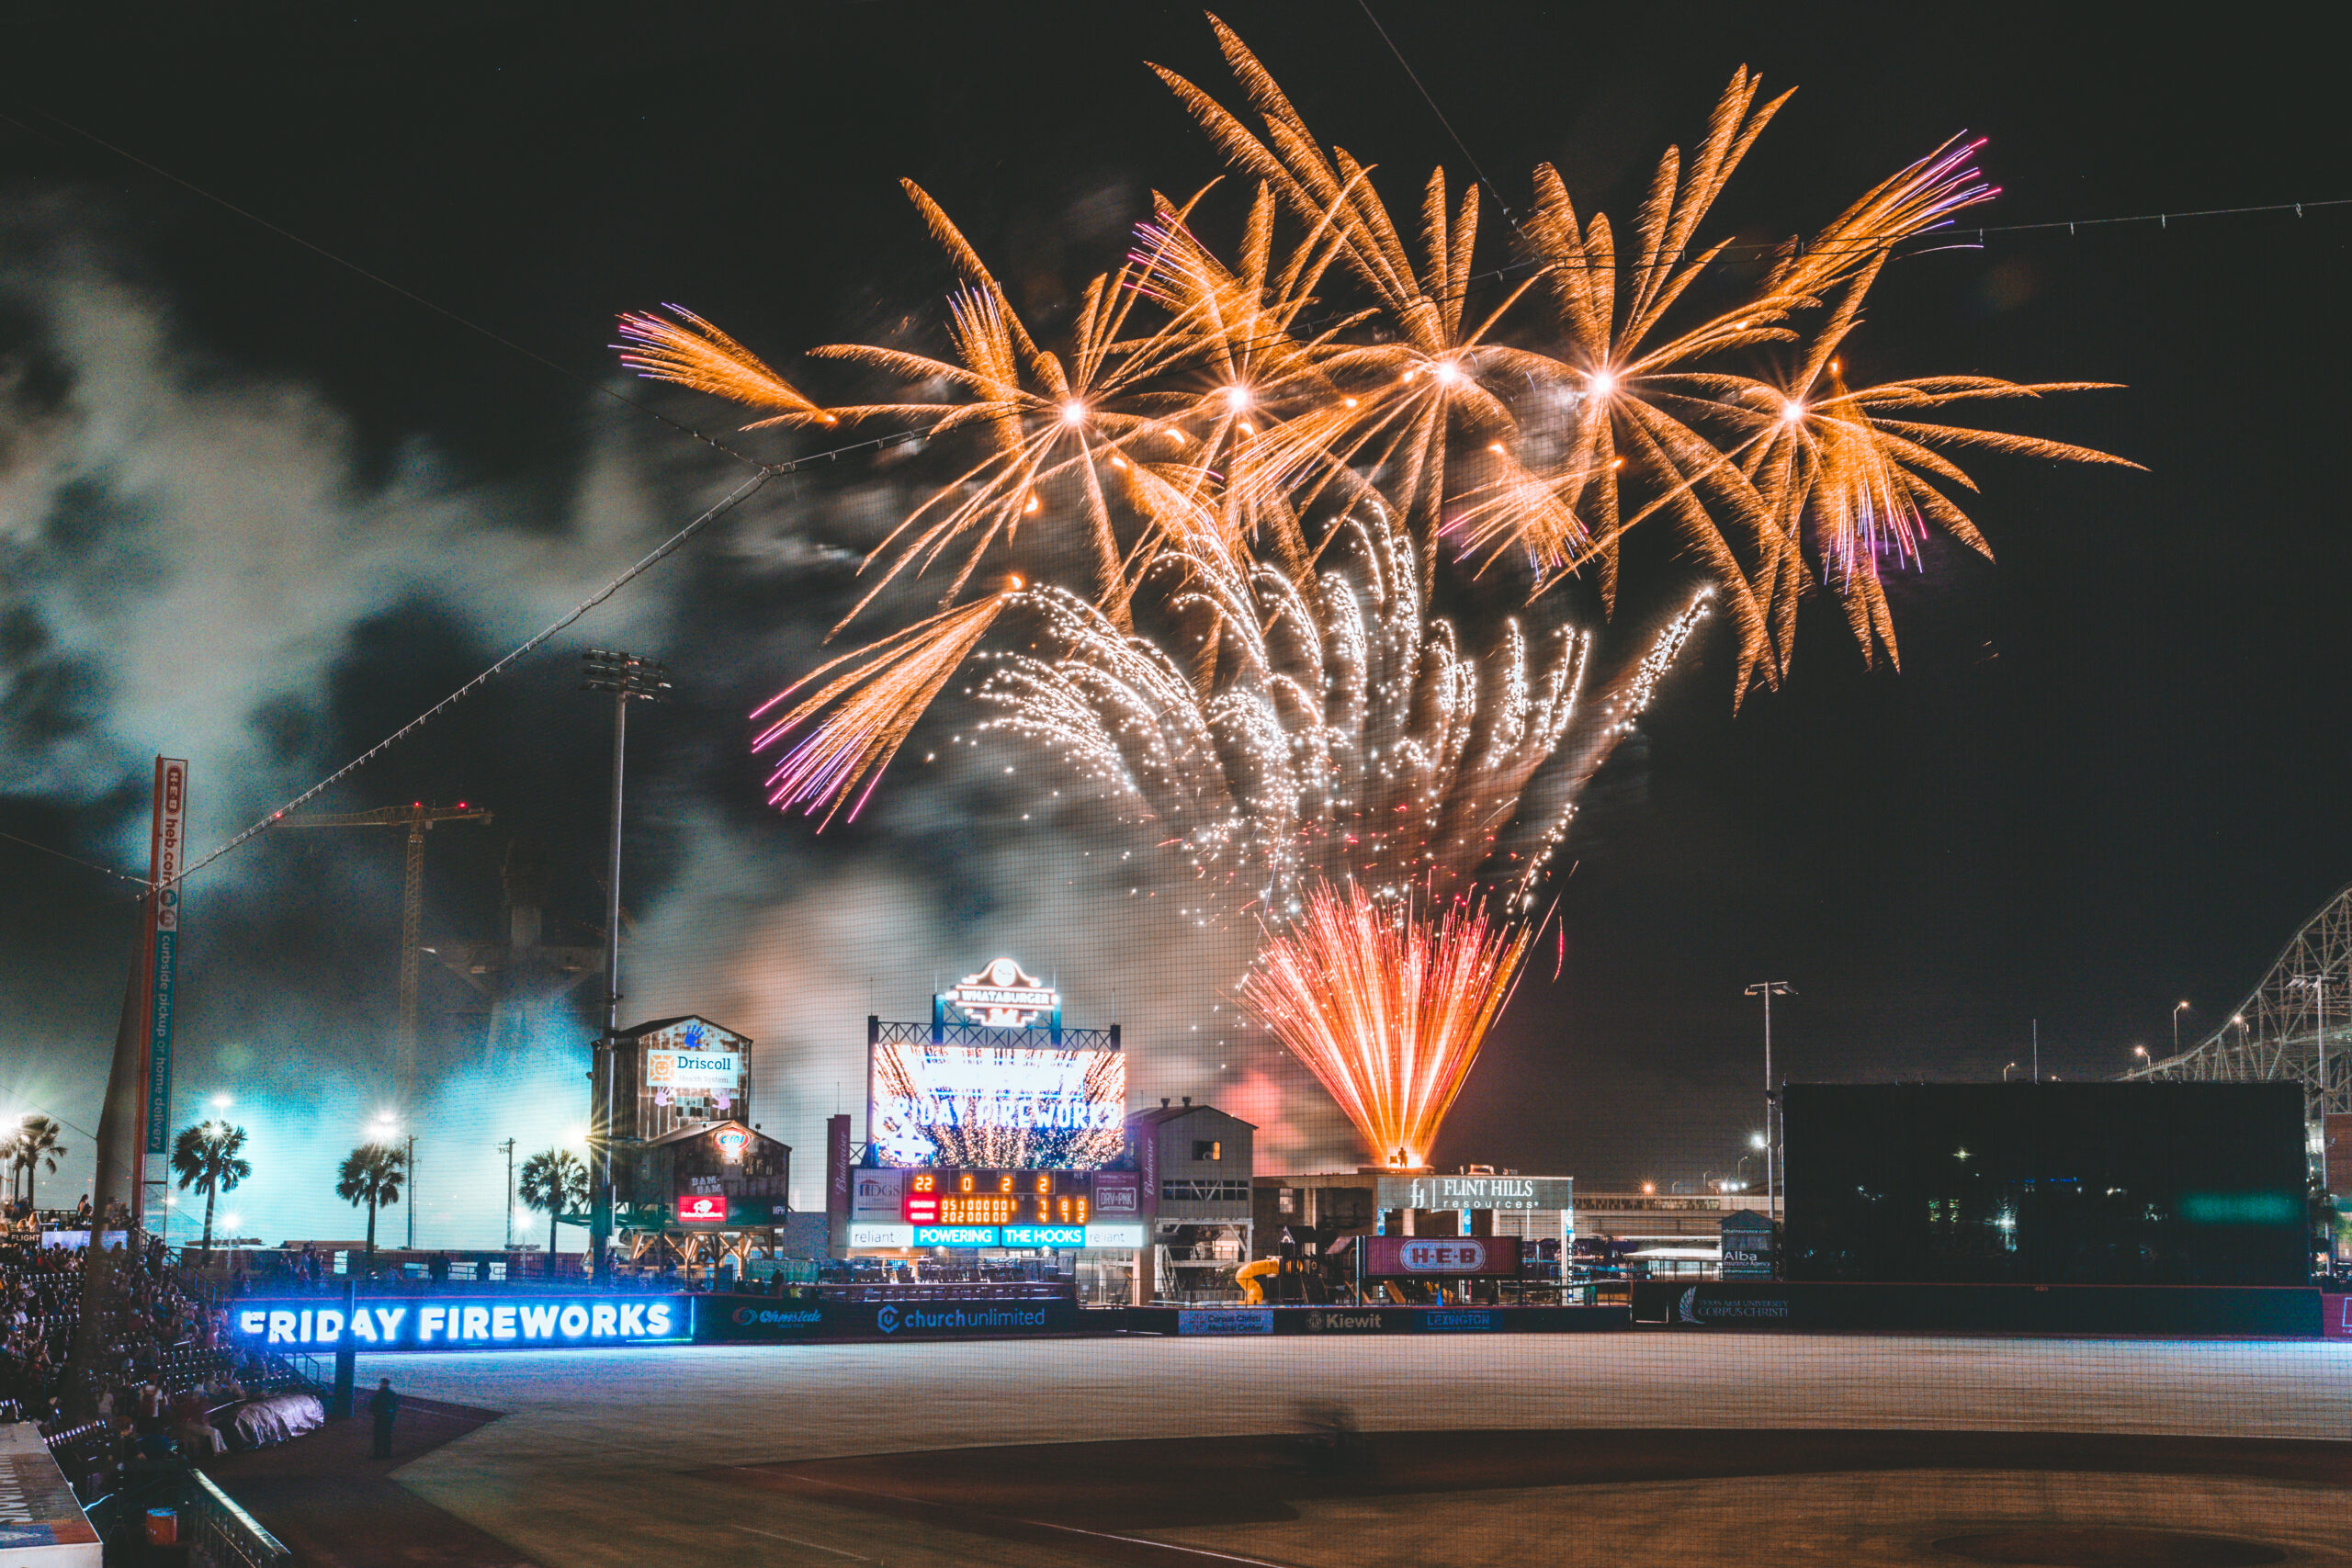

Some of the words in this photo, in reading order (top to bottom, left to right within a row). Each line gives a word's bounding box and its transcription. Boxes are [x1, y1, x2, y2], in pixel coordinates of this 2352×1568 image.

[160, 935, 171, 990] curbside
[961, 990, 1050, 1005] WHATABURGER
[155, 992, 169, 1037] pickup
[156, 1039, 165, 1055] or
[677, 1055, 731, 1070] Driscoll
[154, 1057, 166, 1094] home
[976, 1100, 1122, 1129] FIREWORKS
[151, 1096, 165, 1150] delivery
[836, 1131, 848, 1193] Budweiser
[1143, 1137, 1154, 1198] Budweiser
[696, 1184, 721, 1194] BAM
[916, 1177, 933, 1190] 22
[963, 1178, 972, 1190] 0
[1002, 1178, 1011, 1191] 2
[1039, 1178, 1047, 1191] 2
[1443, 1179, 1487, 1196] FLINT
[1490, 1179, 1533, 1197] HILLS
[773, 1205, 786, 1214] MPH
[11, 1234, 40, 1242] FLIGHT
[854, 1231, 895, 1243] reliant
[920, 1229, 992, 1243] POWERING
[1004, 1229, 1032, 1243] THE
[1034, 1229, 1082, 1243] HOOKS
[1724, 1250, 1758, 1261] Alba
[905, 1309, 966, 1327] church
[967, 1308, 1046, 1326] unlimited
[1208, 1314, 1235, 1325] Corpus
[1237, 1314, 1261, 1323] Christi
[1427, 1314, 1490, 1325] LEXINGTON
[1698, 1308, 1743, 1317] CORPUS
[1744, 1308, 1789, 1317] CHRISTI
[241, 1307, 407, 1343] FRIDAY
[419, 1303, 671, 1340] FIREWORKS
[1326, 1314, 1382, 1329] Kiewit
